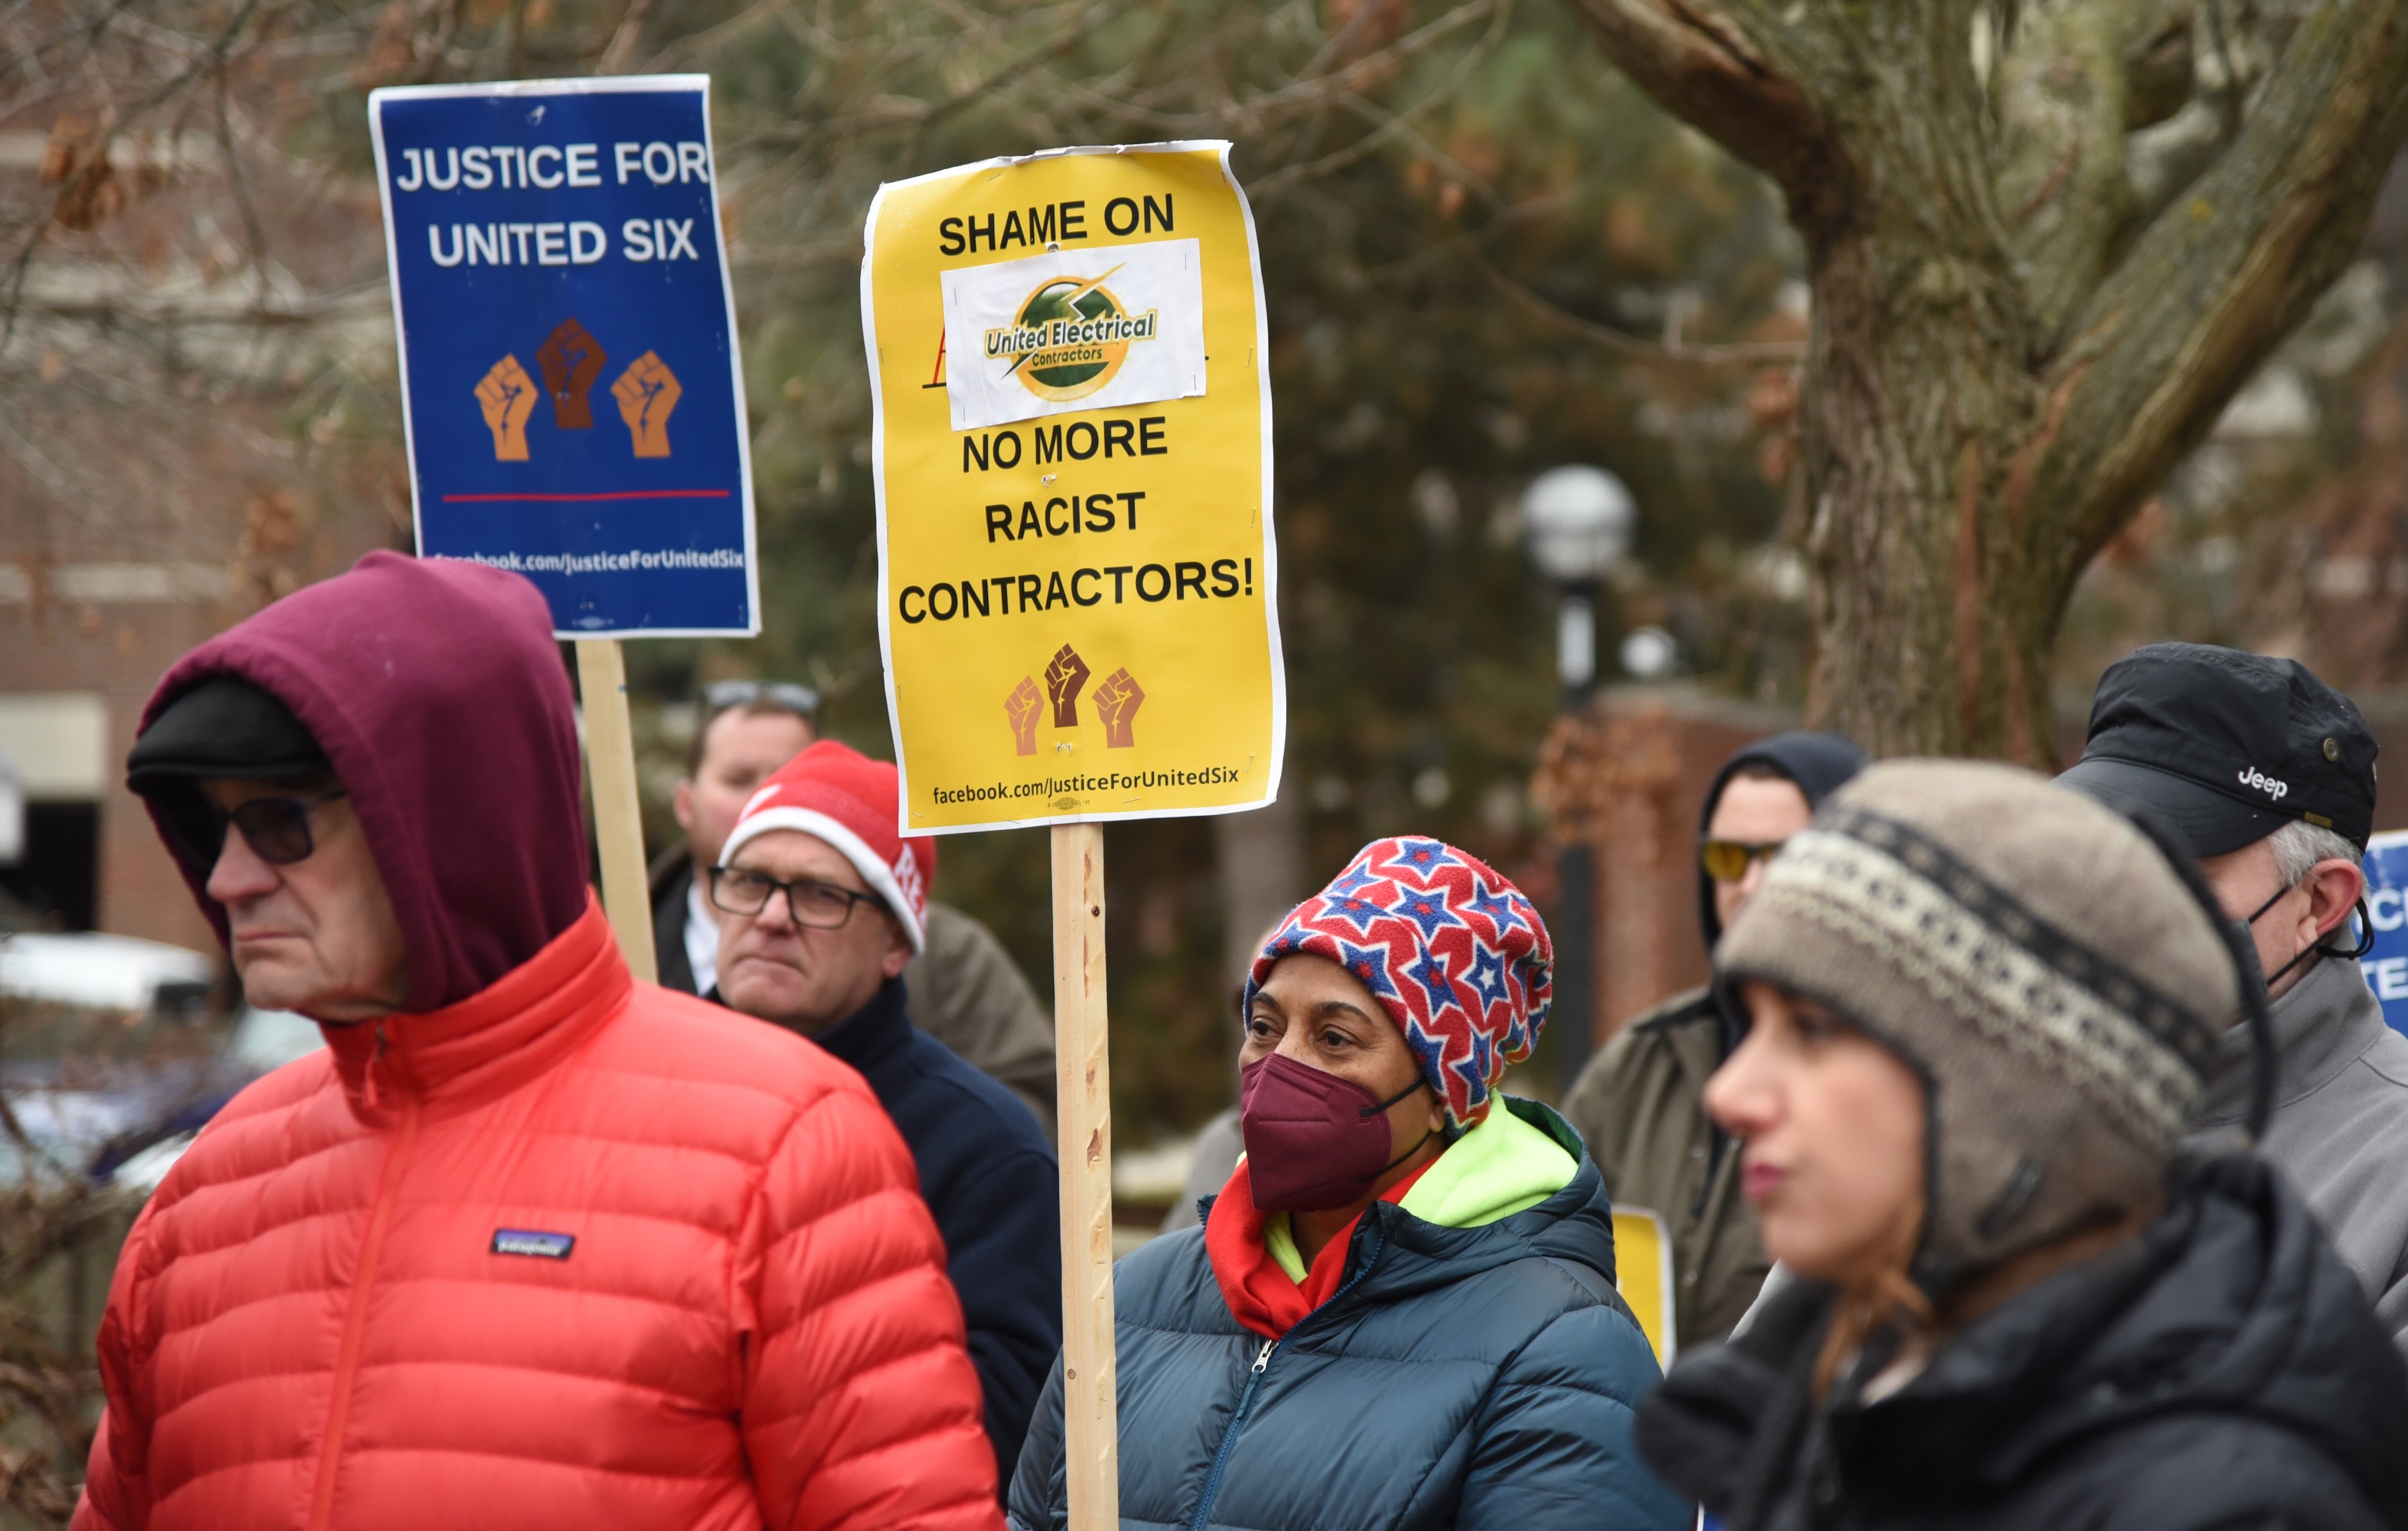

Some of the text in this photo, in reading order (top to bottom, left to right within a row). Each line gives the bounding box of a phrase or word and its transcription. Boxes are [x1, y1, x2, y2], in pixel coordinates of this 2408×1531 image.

[396, 142, 709, 191] JUSTICE FOR
[428, 218, 699, 267] UNITED SIX
[938, 193, 1174, 256] SHAME ON
[986, 313, 1154, 355] United Electrical
[1032, 347, 1103, 367] Contractors
[963, 416, 1168, 473] NO MORE
[985, 491, 1146, 543] RACIST
[433, 548, 744, 576] book.com/JusticeForUnitedSix
[899, 557, 1254, 624] CONTRACTORS!
[932, 766, 1239, 805] facebook.com/JusticeForUnitedSix
[2238, 766, 2288, 801] Jeep
